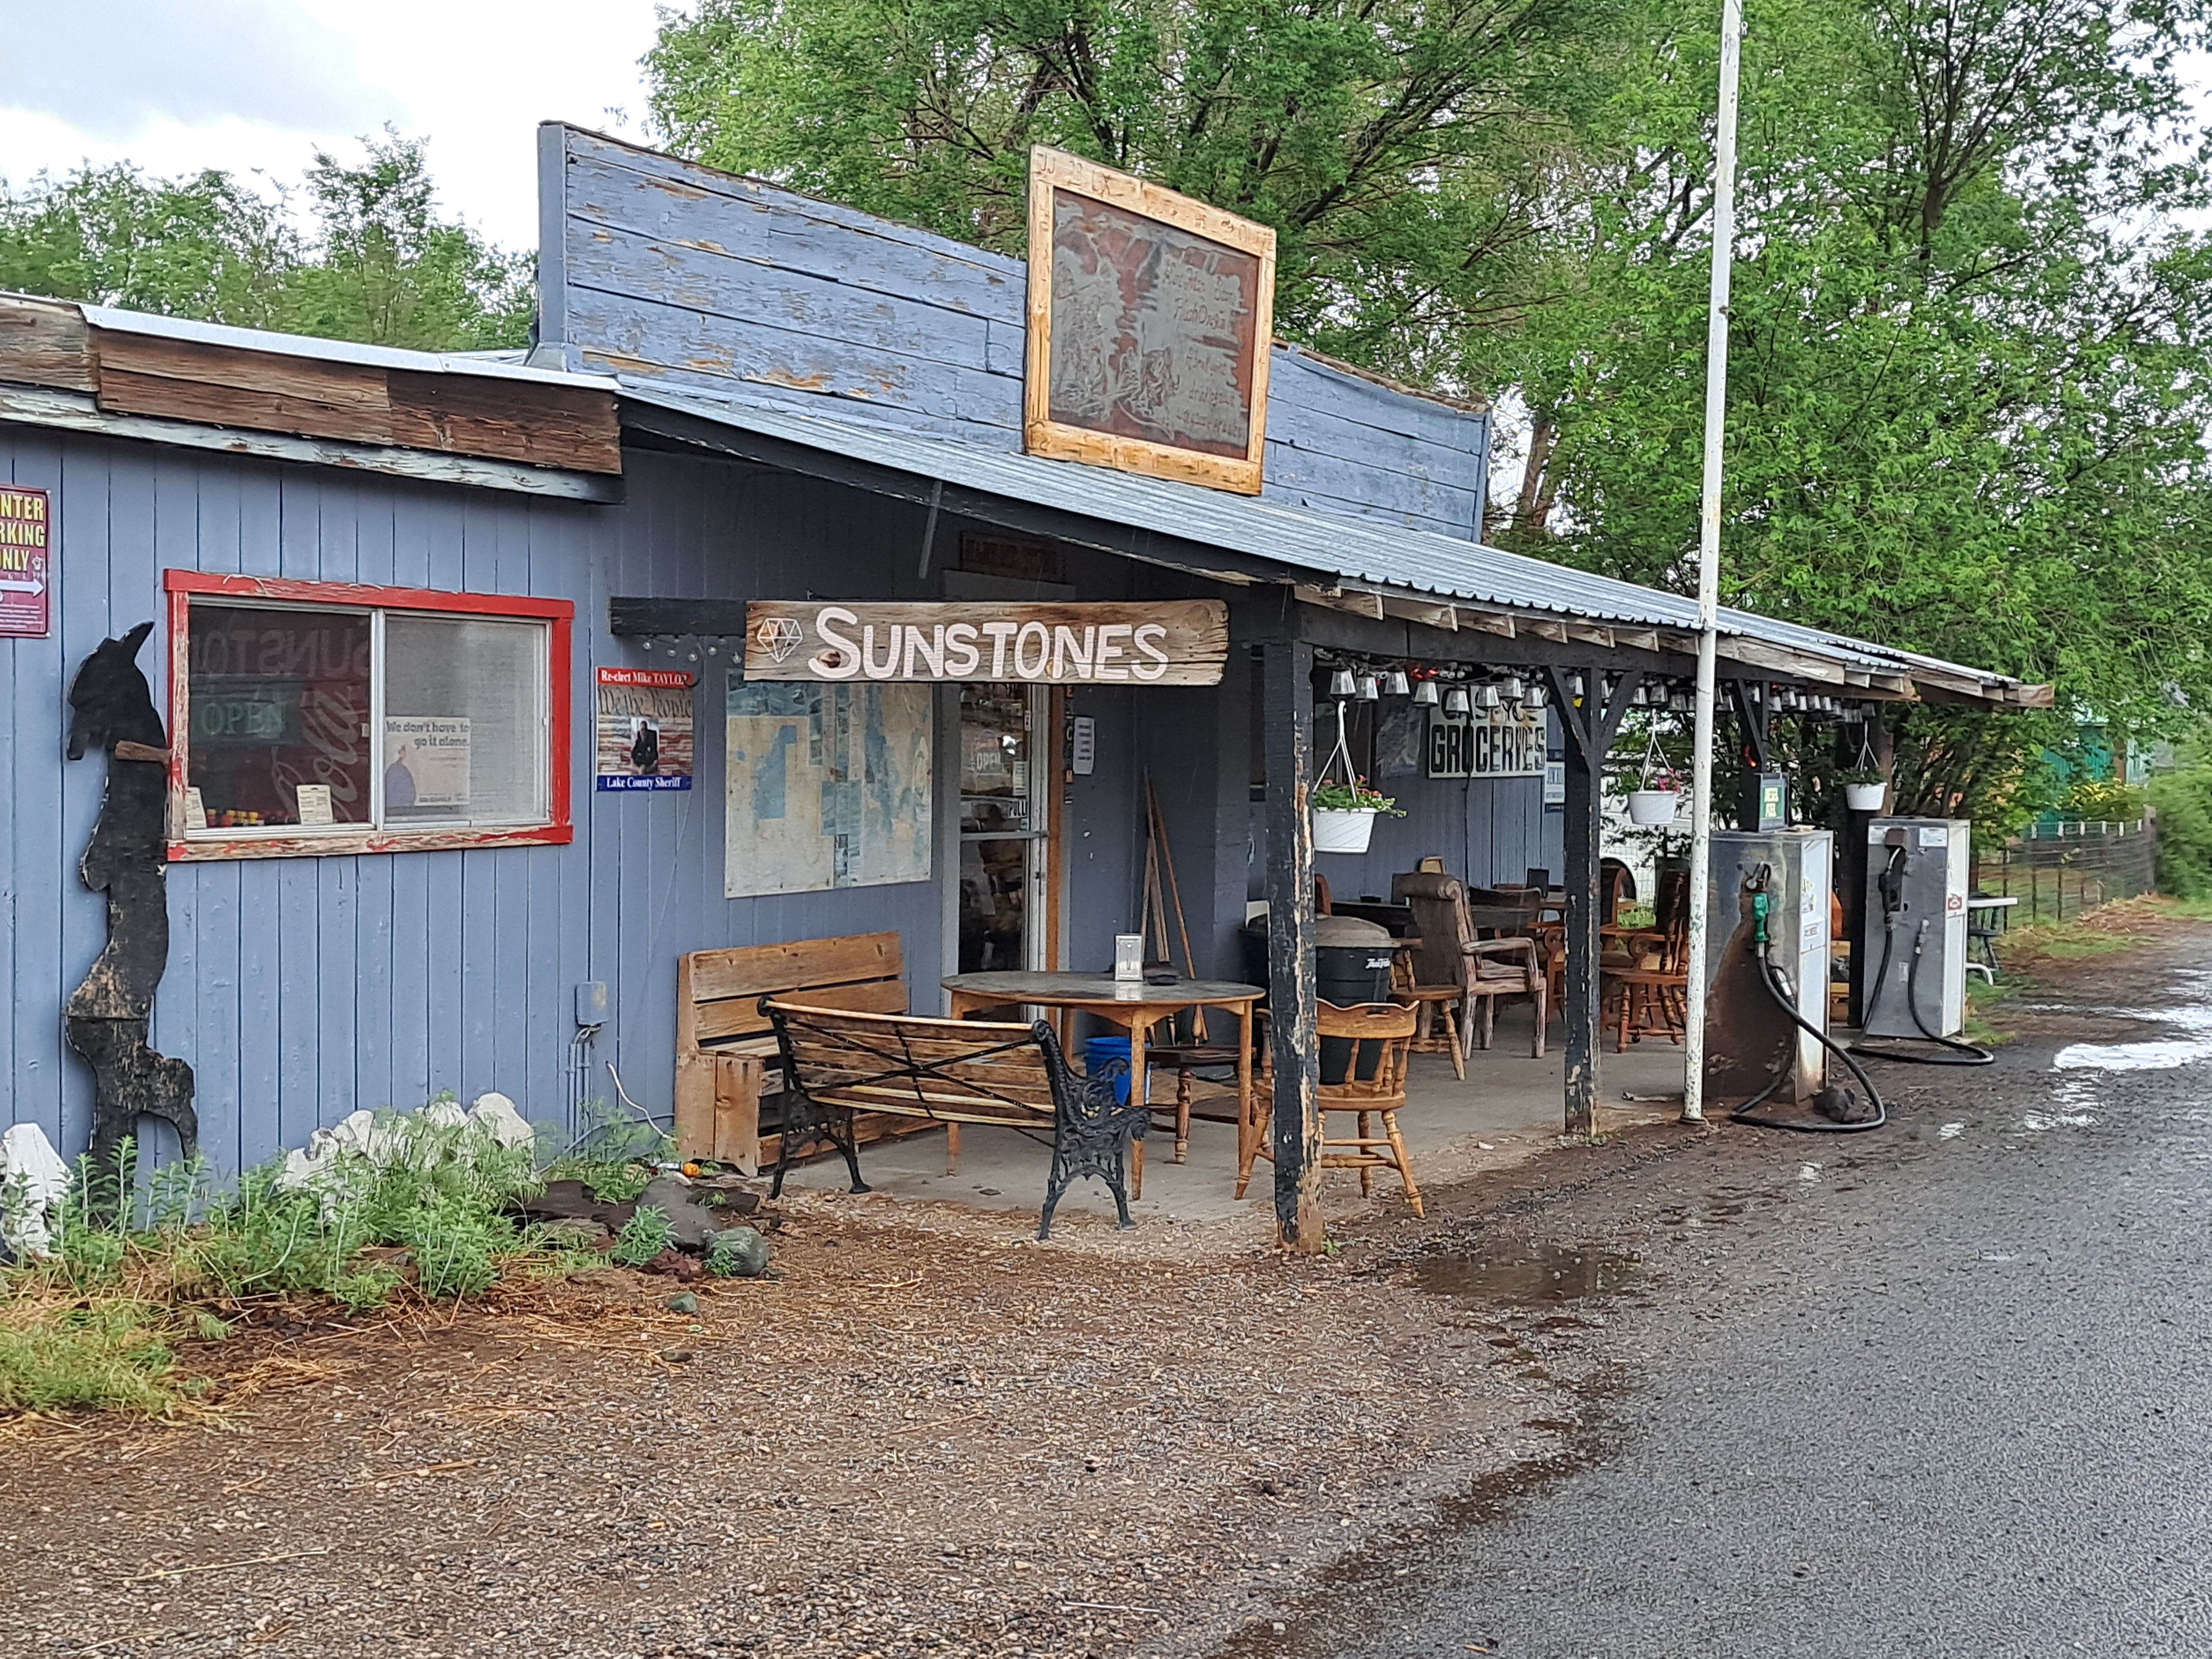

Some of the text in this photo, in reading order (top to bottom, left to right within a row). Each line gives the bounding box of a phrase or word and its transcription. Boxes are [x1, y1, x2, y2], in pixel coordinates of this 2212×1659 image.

[0, 548, 30, 571] NLY
[808, 607, 1170, 680] SUNSTONES
[632, 672, 651, 684] Mike
[201, 702, 285, 735] OPEN
[386, 720, 470, 733] We don't have to
[414, 738, 427, 750] go
[429, 735, 437, 746] it
[1431, 724, 1545, 773] GROCERIES
[976, 752, 1001, 771] OPEN
[607, 777, 681, 790] Lake County Sheriff
